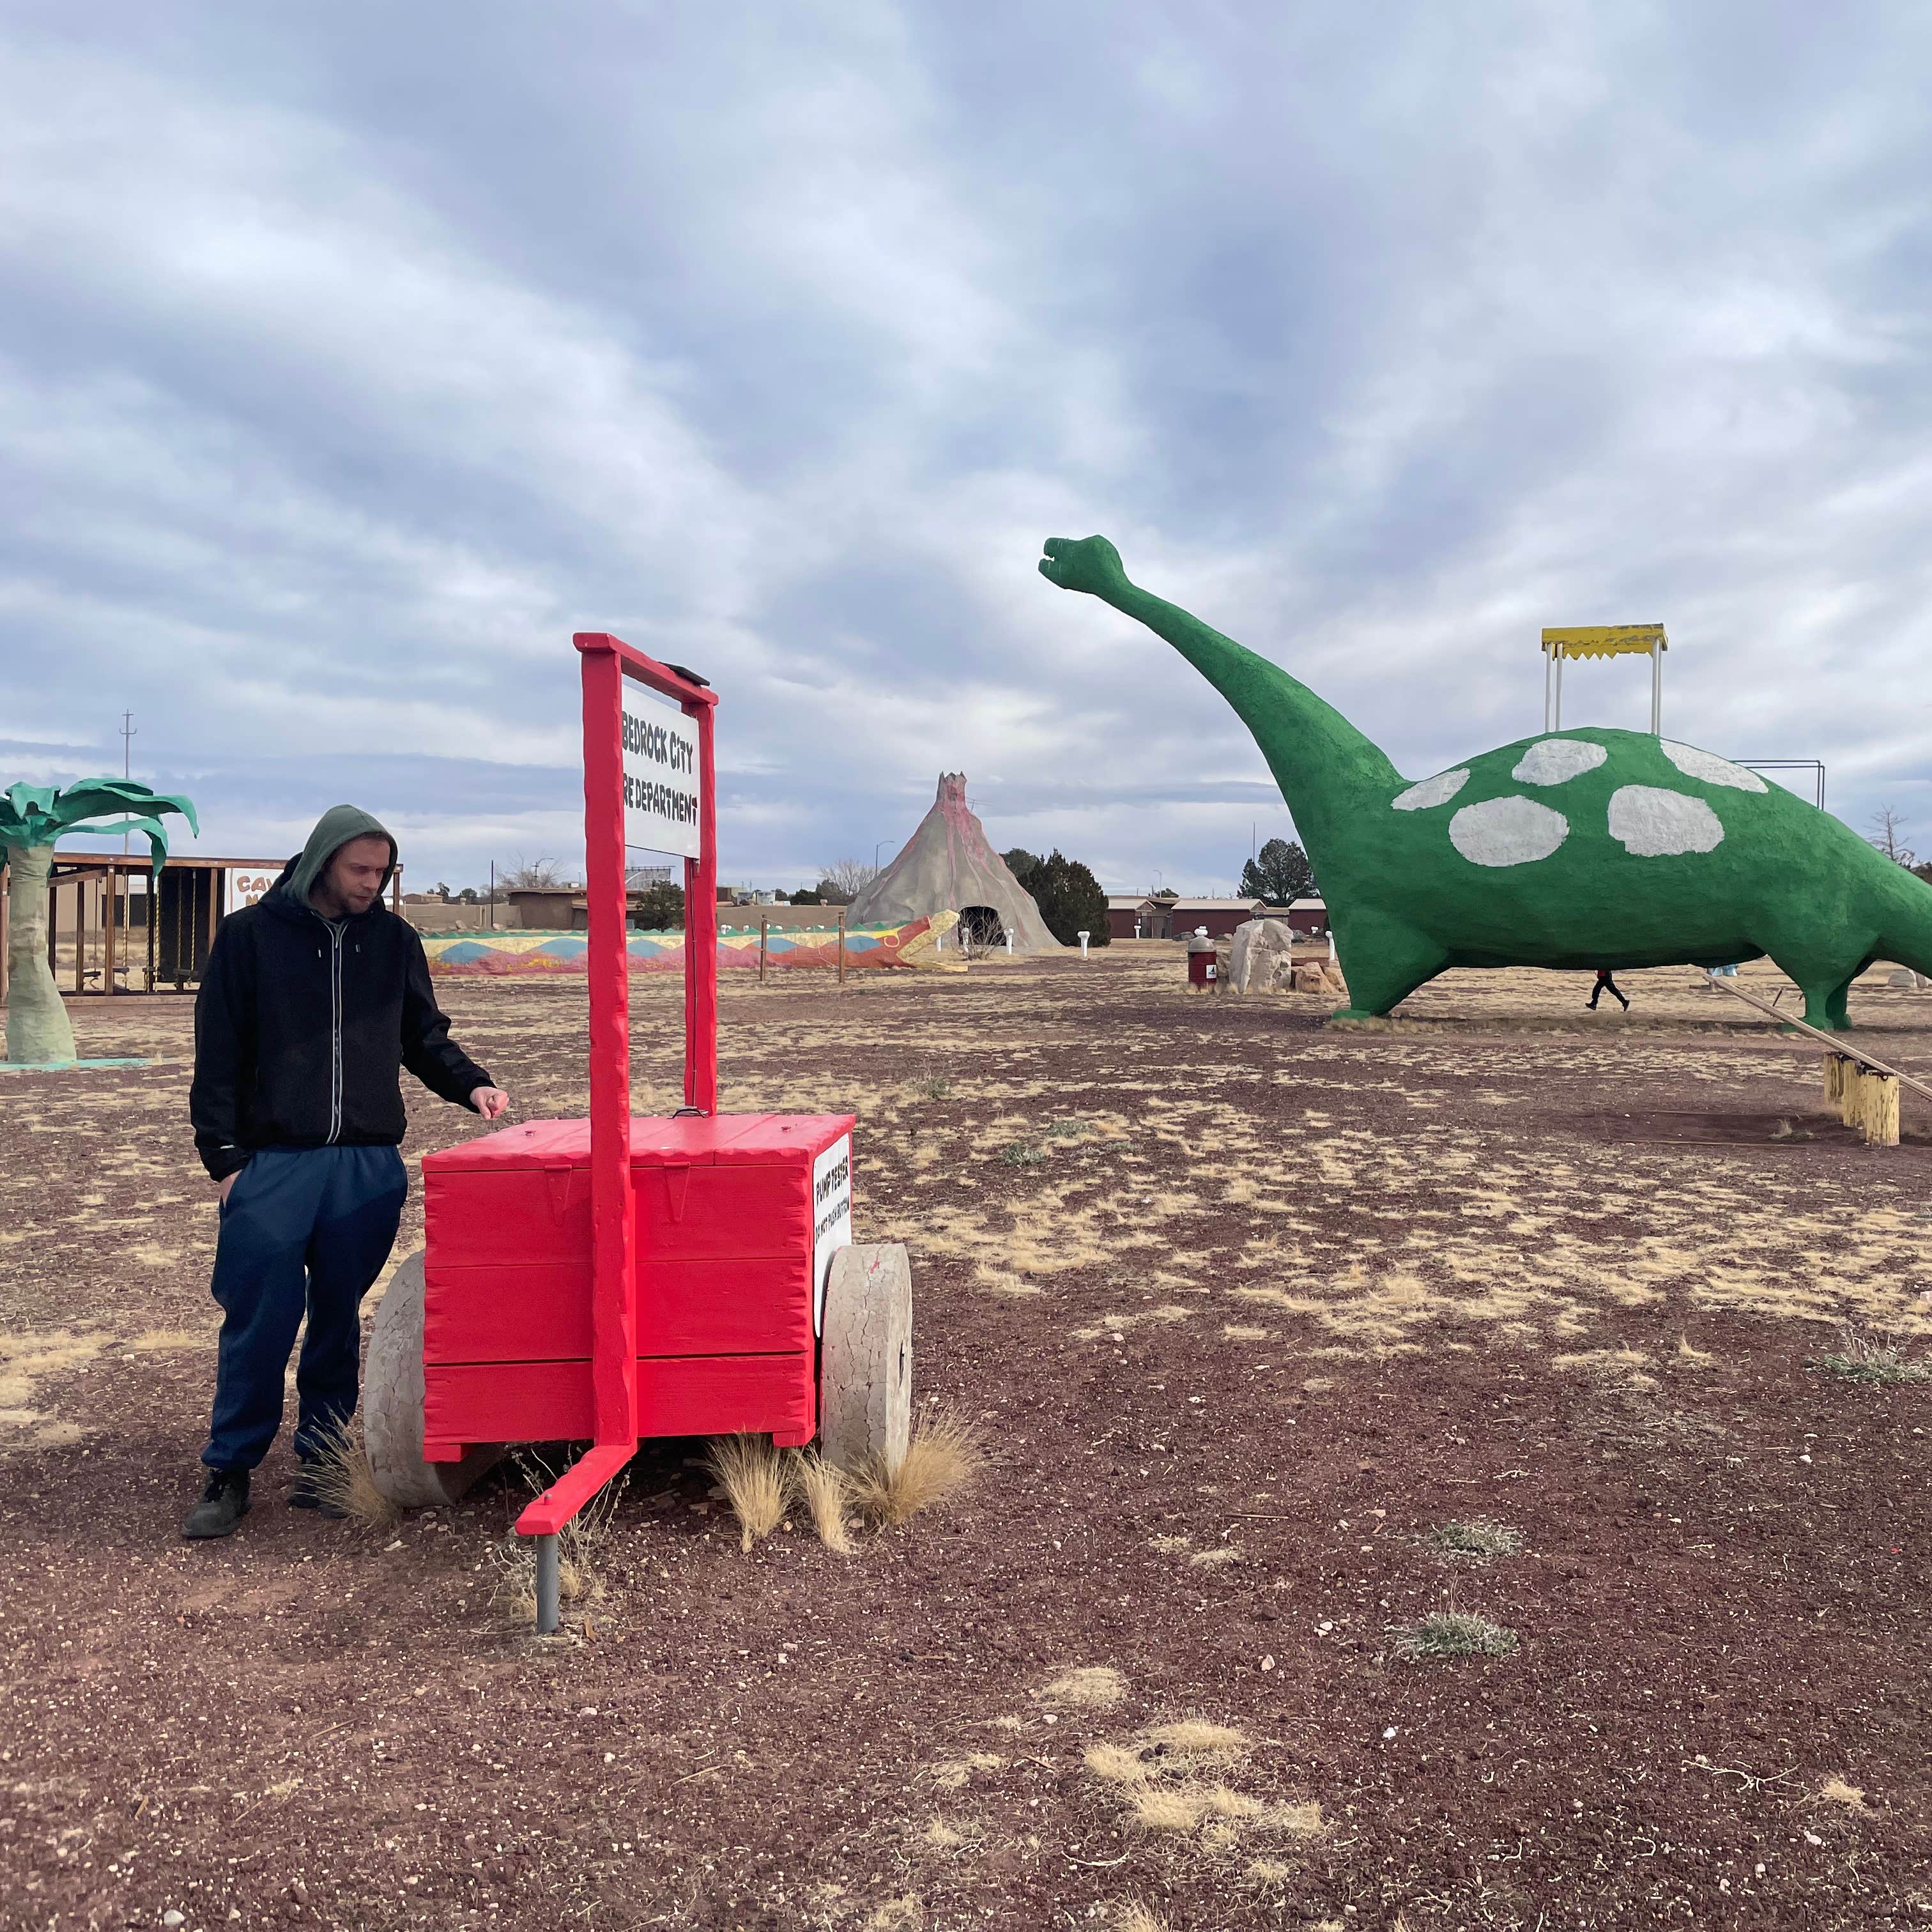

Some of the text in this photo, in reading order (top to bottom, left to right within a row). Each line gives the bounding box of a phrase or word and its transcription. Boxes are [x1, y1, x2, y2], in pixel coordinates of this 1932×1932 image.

[622, 710, 668, 764] BEDROCK
[636, 778, 698, 827] DEPARTMENT
[816, 1154, 848, 1207] PUMP TESTER
[815, 1223, 820, 1245] DO
